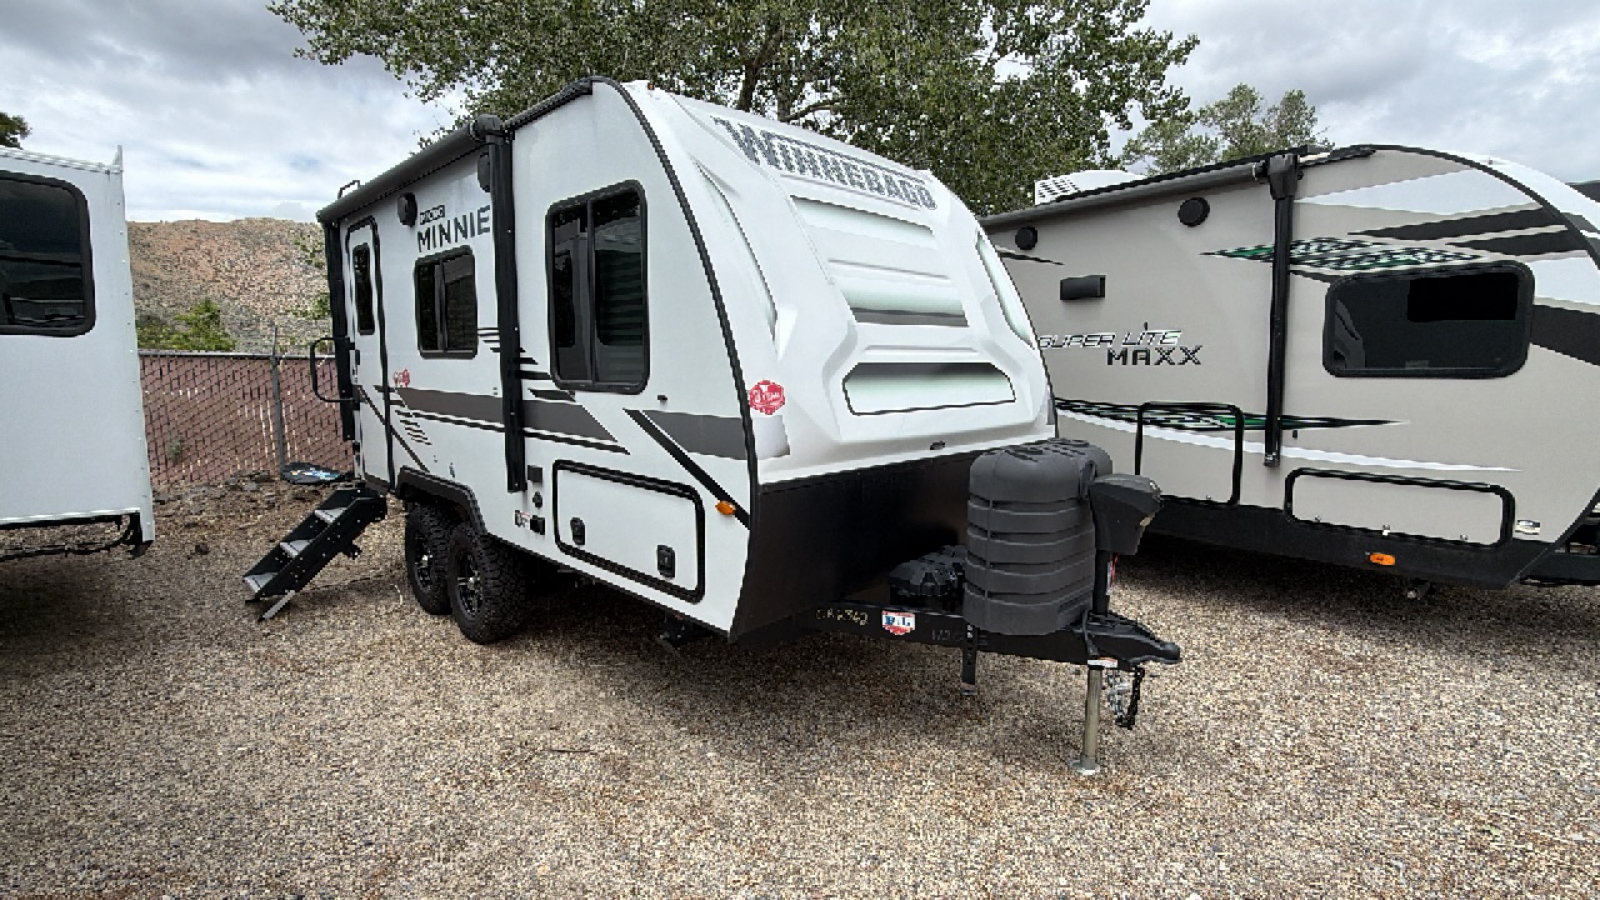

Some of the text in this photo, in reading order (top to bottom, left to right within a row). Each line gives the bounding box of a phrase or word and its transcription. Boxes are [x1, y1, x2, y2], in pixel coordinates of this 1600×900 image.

[710, 116, 938, 210] WINNEBAGO
[417, 205, 491, 253] MINNIE
[1040, 332, 1116, 348] SUPER
[1107, 345, 1202, 366] MAXX
